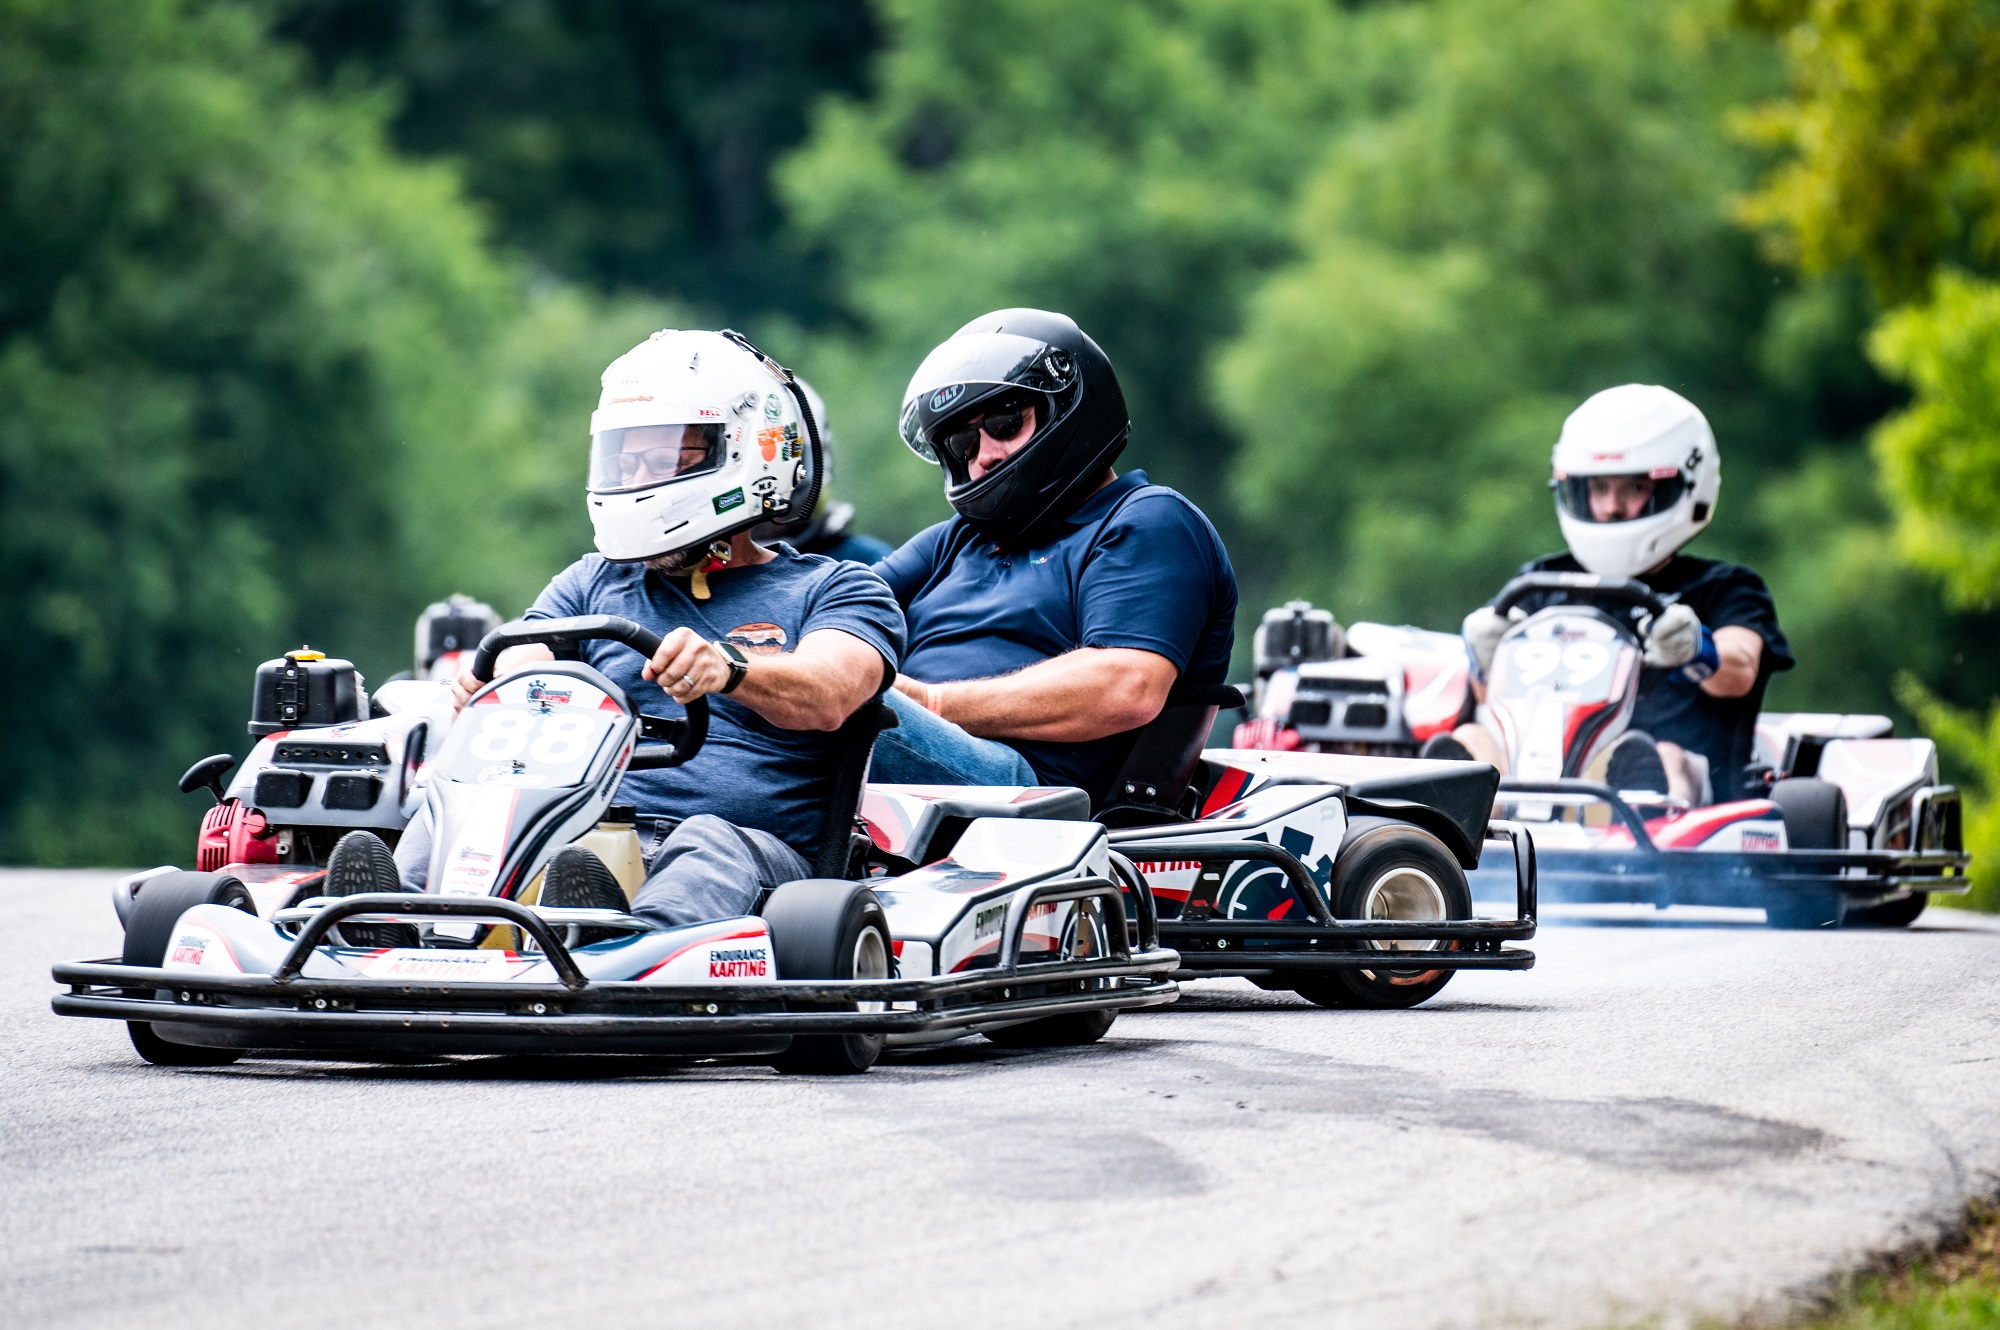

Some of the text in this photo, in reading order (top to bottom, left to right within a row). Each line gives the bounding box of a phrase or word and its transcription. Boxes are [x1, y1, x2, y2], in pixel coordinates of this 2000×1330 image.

[699, 409, 721, 417] BELL
[1513, 640, 1610, 686] 99
[469, 708, 597, 765] 88
[710, 949, 766, 961] ENDURANCE
[388, 962, 485, 977] KARTING
[709, 960, 767, 977] KARTING
